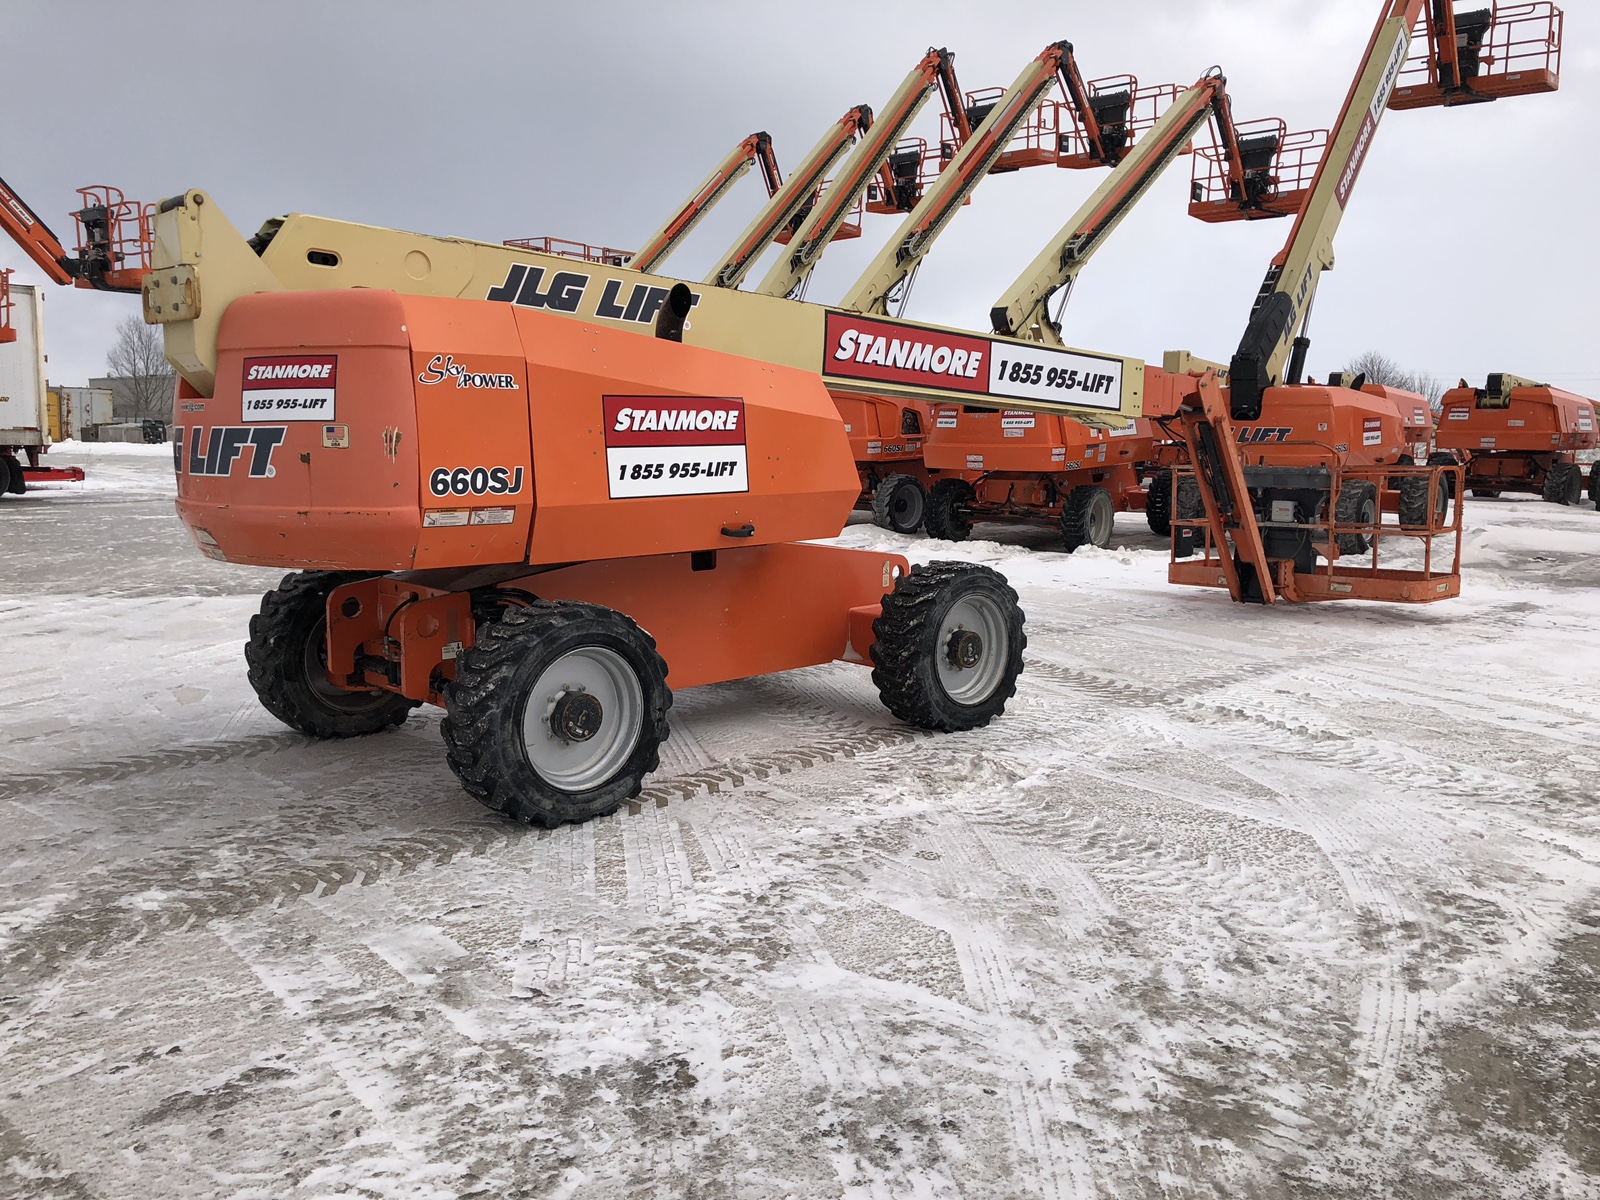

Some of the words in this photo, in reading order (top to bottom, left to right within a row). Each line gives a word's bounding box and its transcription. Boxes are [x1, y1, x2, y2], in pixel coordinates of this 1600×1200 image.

[1340, 117, 1371, 200] STANMORE
[485, 262, 591, 314] JLG
[1283, 304, 1297, 346] JLG
[1297, 261, 1312, 310] LIFT
[833, 329, 983, 379] STANMORE
[247, 364, 332, 380] STANMORE
[464, 373, 515, 388] POWER
[998, 360, 1008, 381] 1
[1008, 362, 1044, 385] 855
[1045, 367, 1115, 395] 955-LIFT
[247, 400, 252, 410] 1
[253, 399, 274, 410] 855
[276, 398, 327, 409] 955-LIFT
[613, 407, 739, 432] STANMORE
[884, 444, 904, 453] 660SJ
[1236, 427, 1293, 443] LIFT
[189, 425, 288, 478] LIFT
[429, 466, 524, 497] 660SJ
[619, 465, 627, 481] 1
[631, 463, 664, 480] 855
[669, 461, 737, 478] 955-LIFT
